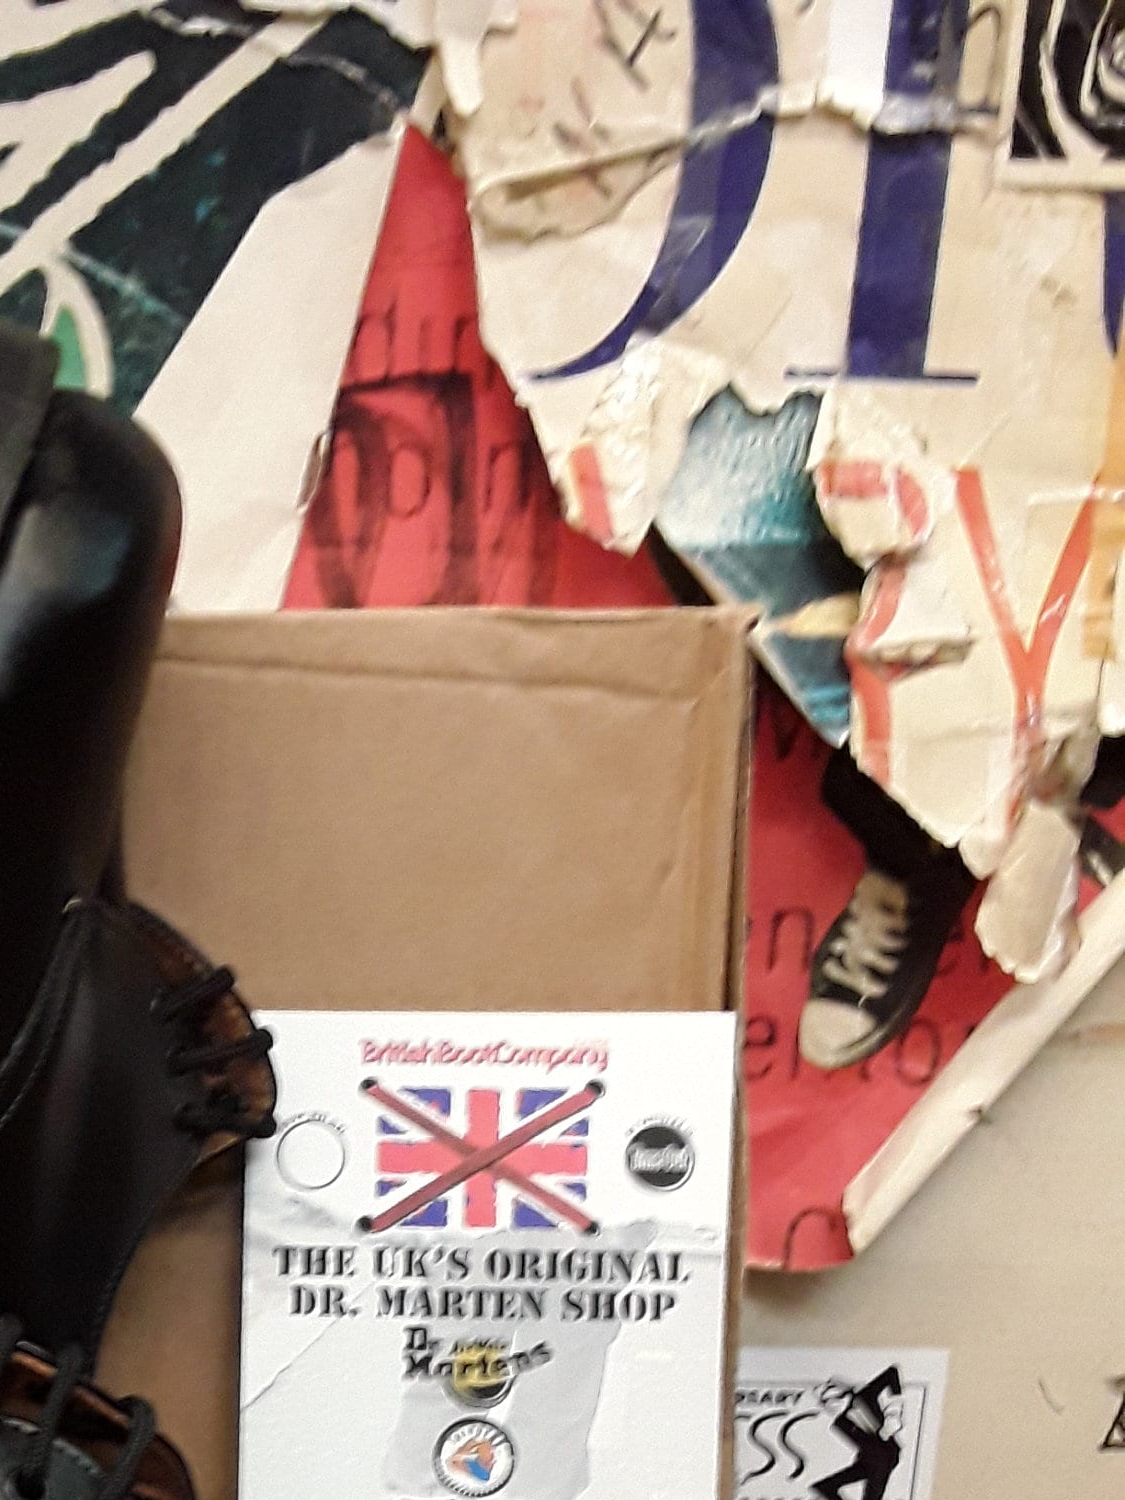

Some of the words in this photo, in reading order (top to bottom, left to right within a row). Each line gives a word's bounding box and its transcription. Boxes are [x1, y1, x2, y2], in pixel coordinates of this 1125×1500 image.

[275, 1245, 356, 1277] THE
[376, 1246, 470, 1280] UK'S
[483, 1249, 690, 1284] ORIGINAL
[289, 1285, 359, 1318] DR.
[376, 1286, 550, 1320] MARTEN
[559, 1289, 677, 1322] SHOP
